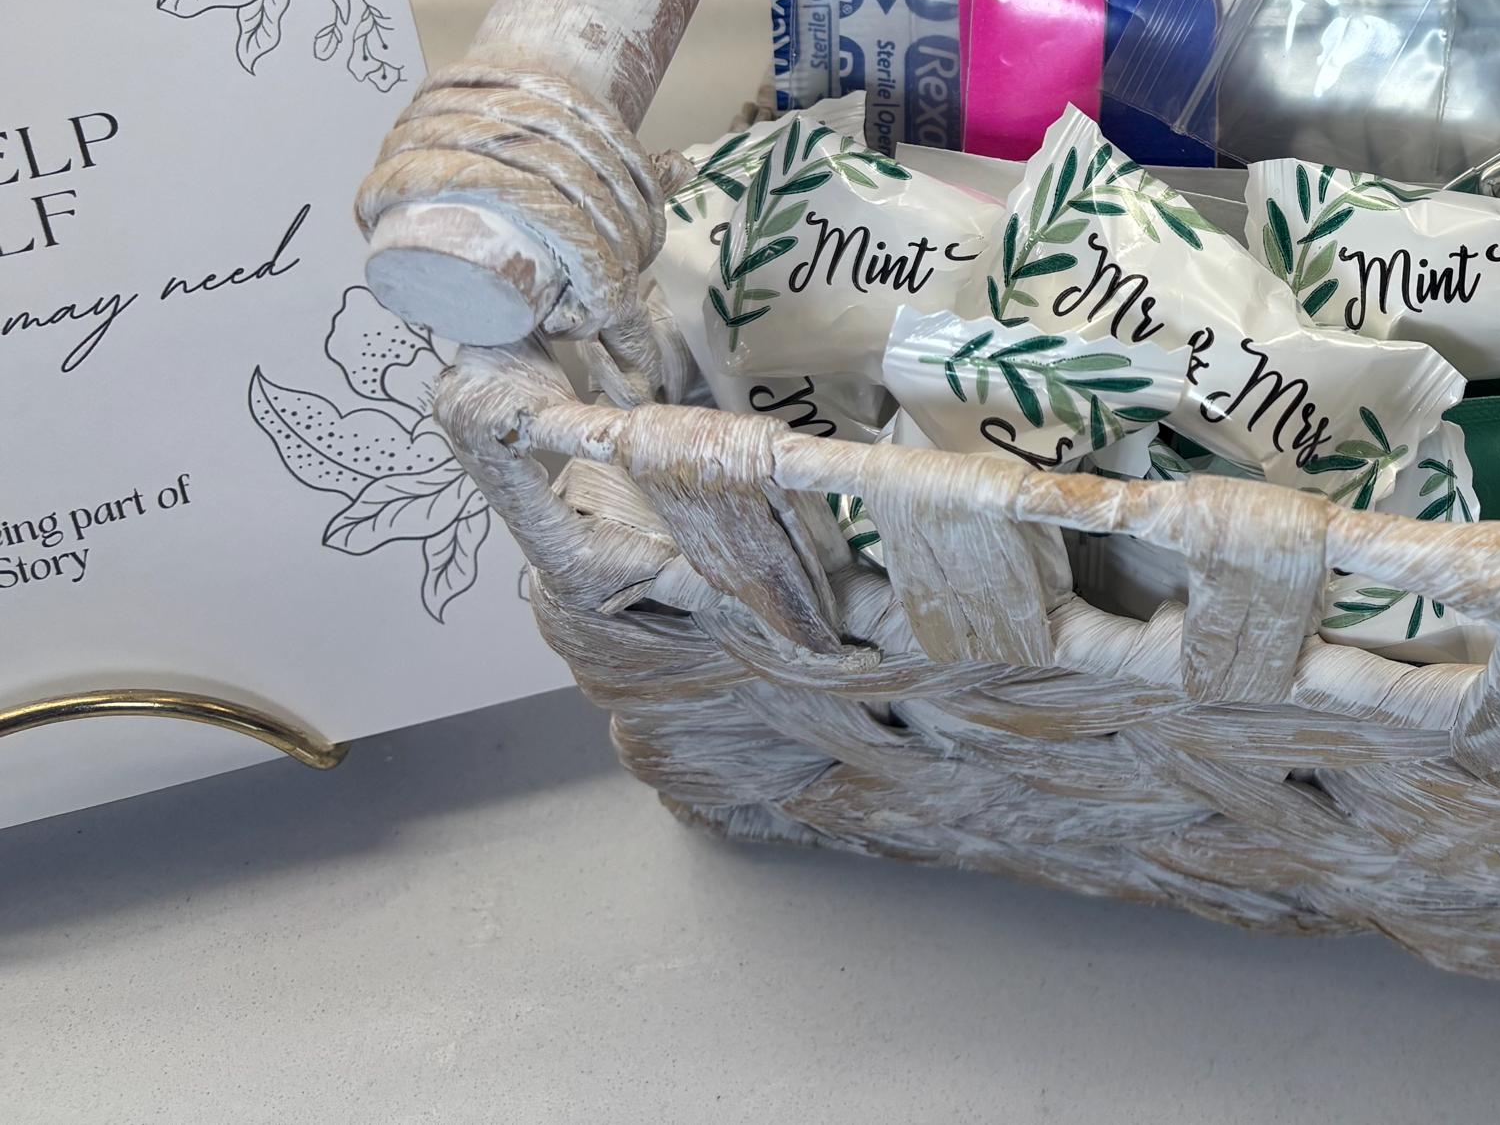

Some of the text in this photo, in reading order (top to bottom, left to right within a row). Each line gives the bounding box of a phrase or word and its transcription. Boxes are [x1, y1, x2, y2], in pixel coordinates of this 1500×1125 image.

[809, 10, 829, 71] Sterile
[876, 39, 896, 100] Sterile
[789, 211, 938, 293] Mint
[2, 204, 311, 373] may need
[1339, 243, 1482, 331] Mint
[68, 488, 147, 540] part
[157, 473, 191, 510] of
[0, 548, 90, 589] Story
